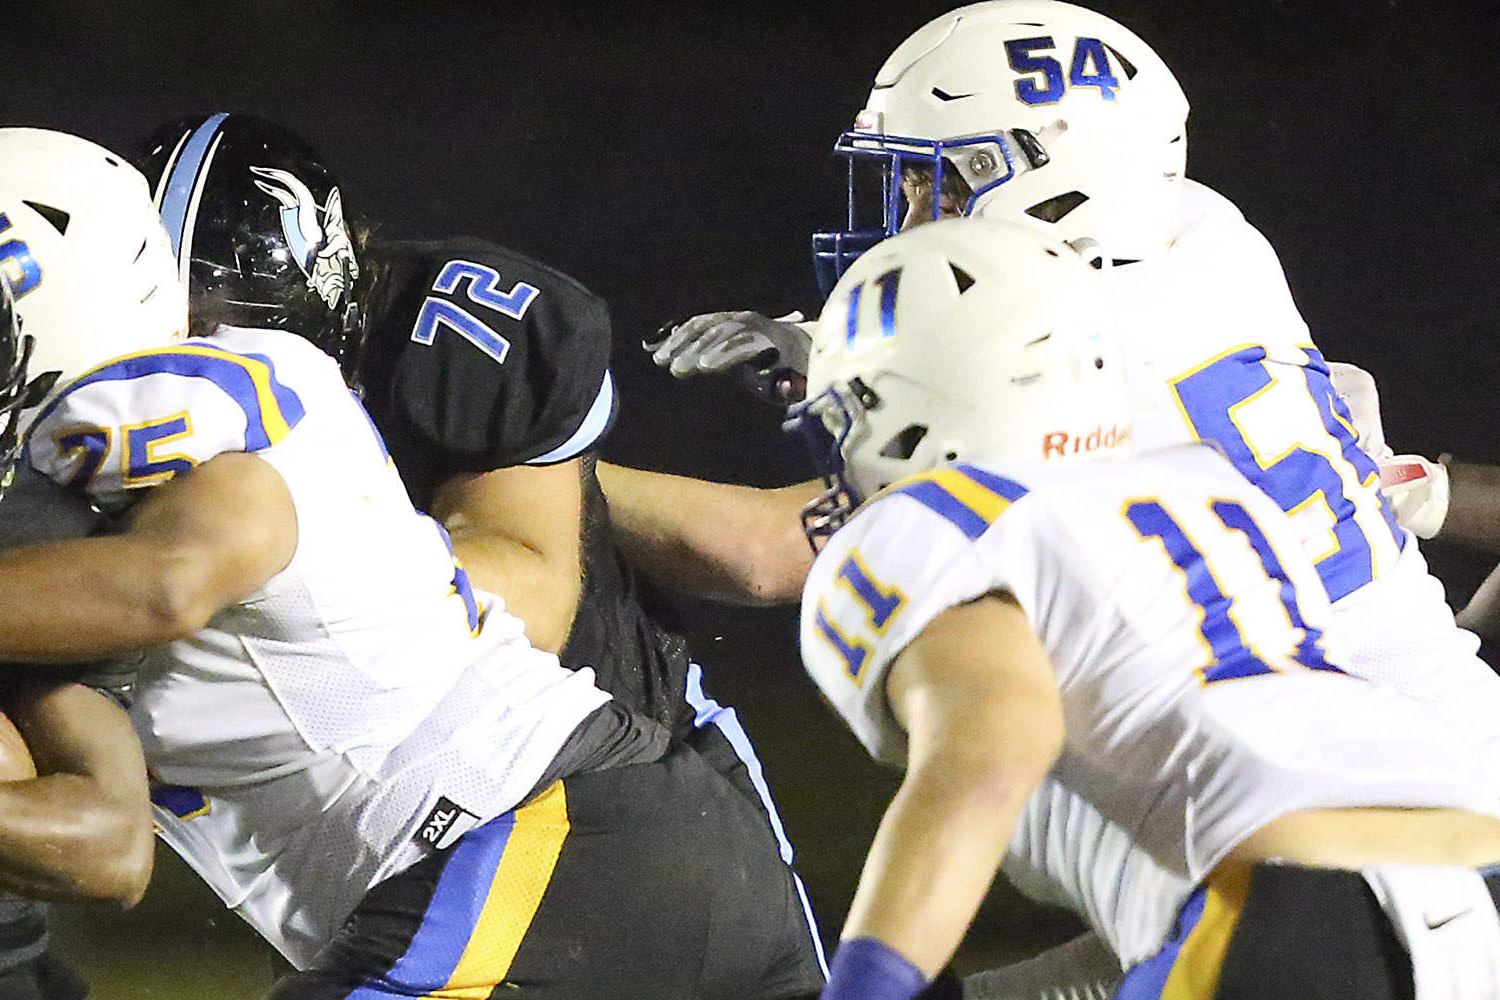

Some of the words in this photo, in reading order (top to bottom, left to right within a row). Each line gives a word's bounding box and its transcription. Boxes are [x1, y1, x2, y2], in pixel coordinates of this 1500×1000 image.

[1003, 36, 1121, 107] 54
[411, 259, 541, 365] 72
[843, 264, 903, 358] 11
[814, 547, 911, 689] 11
[1120, 497, 1358, 689] 11
[423, 809, 456, 842] 2XL
